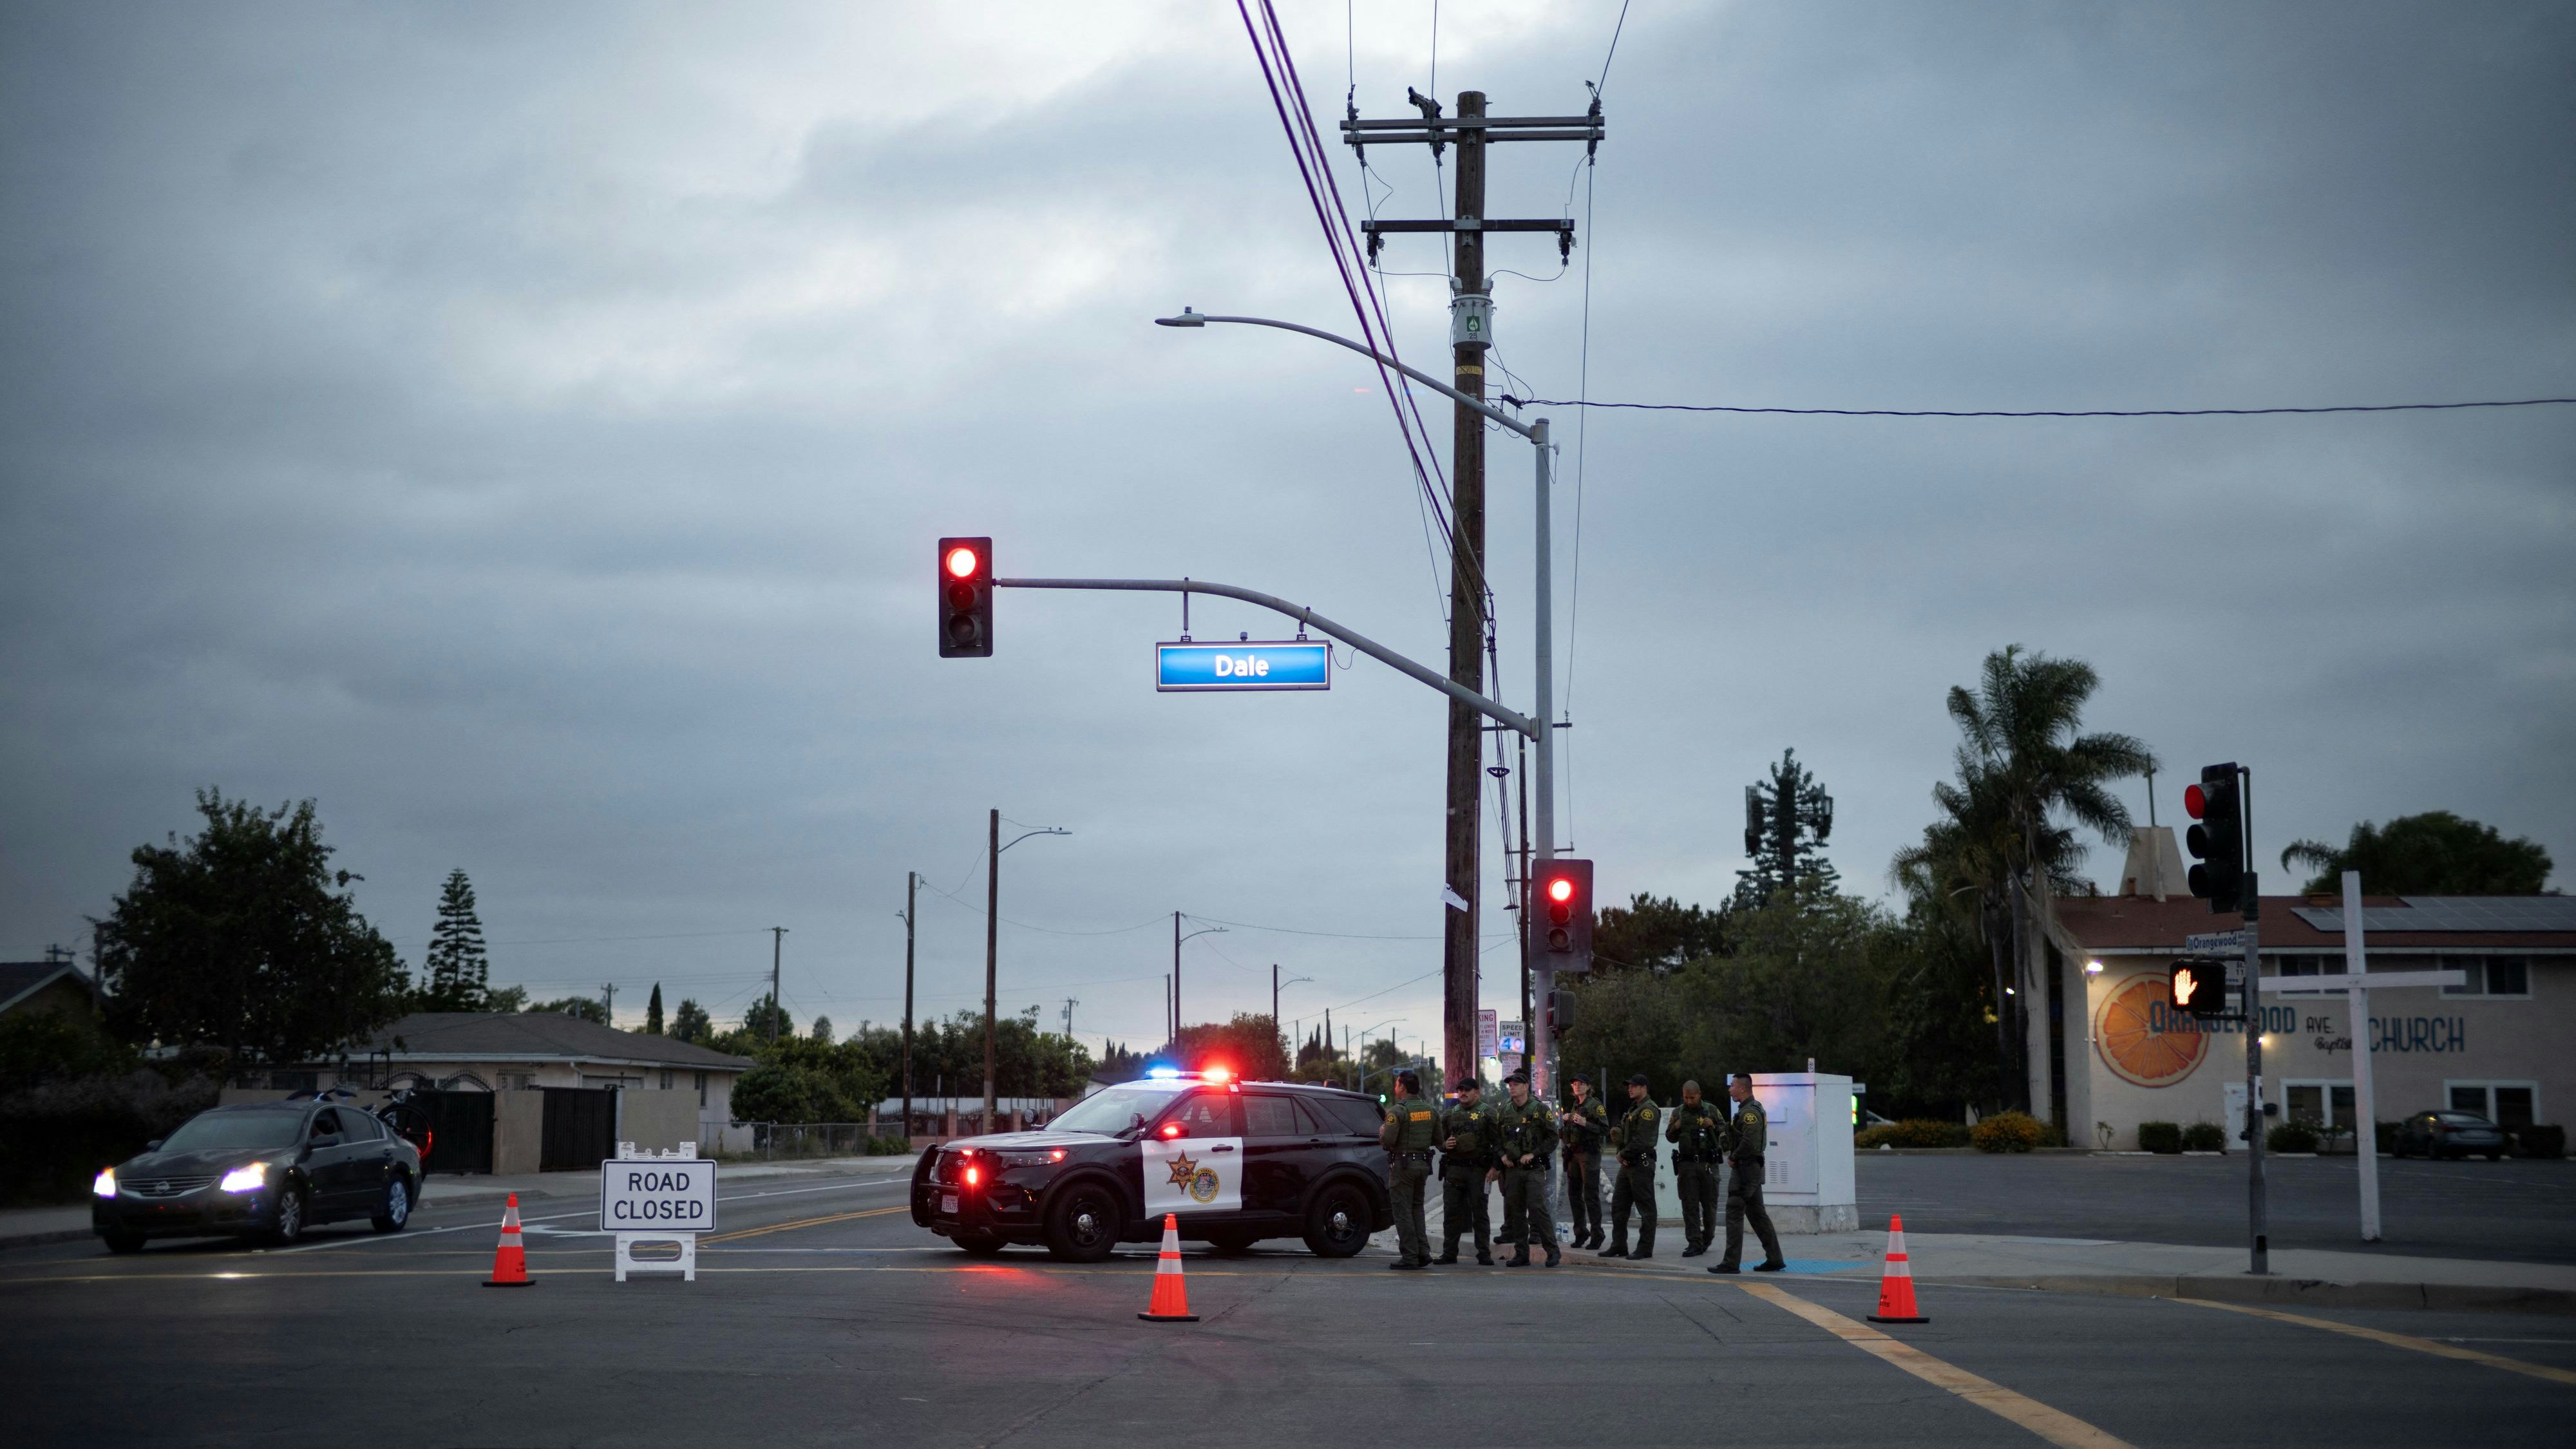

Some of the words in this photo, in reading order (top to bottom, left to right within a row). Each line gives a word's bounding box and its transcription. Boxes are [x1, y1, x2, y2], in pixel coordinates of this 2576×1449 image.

[1215, 654, 1269, 677] Dale
[2193, 933, 2237, 950] Orangewood
[2368, 1016, 2465, 1052] CHURCH
[1502, 1037, 1522, 1050] 40
[2314, 1037, 2352, 1055] Baptis
[1410, 1111, 1431, 1121] SHERIFF
[629, 1172, 690, 1191] ROAD
[614, 1200, 703, 1220] CLOSED
